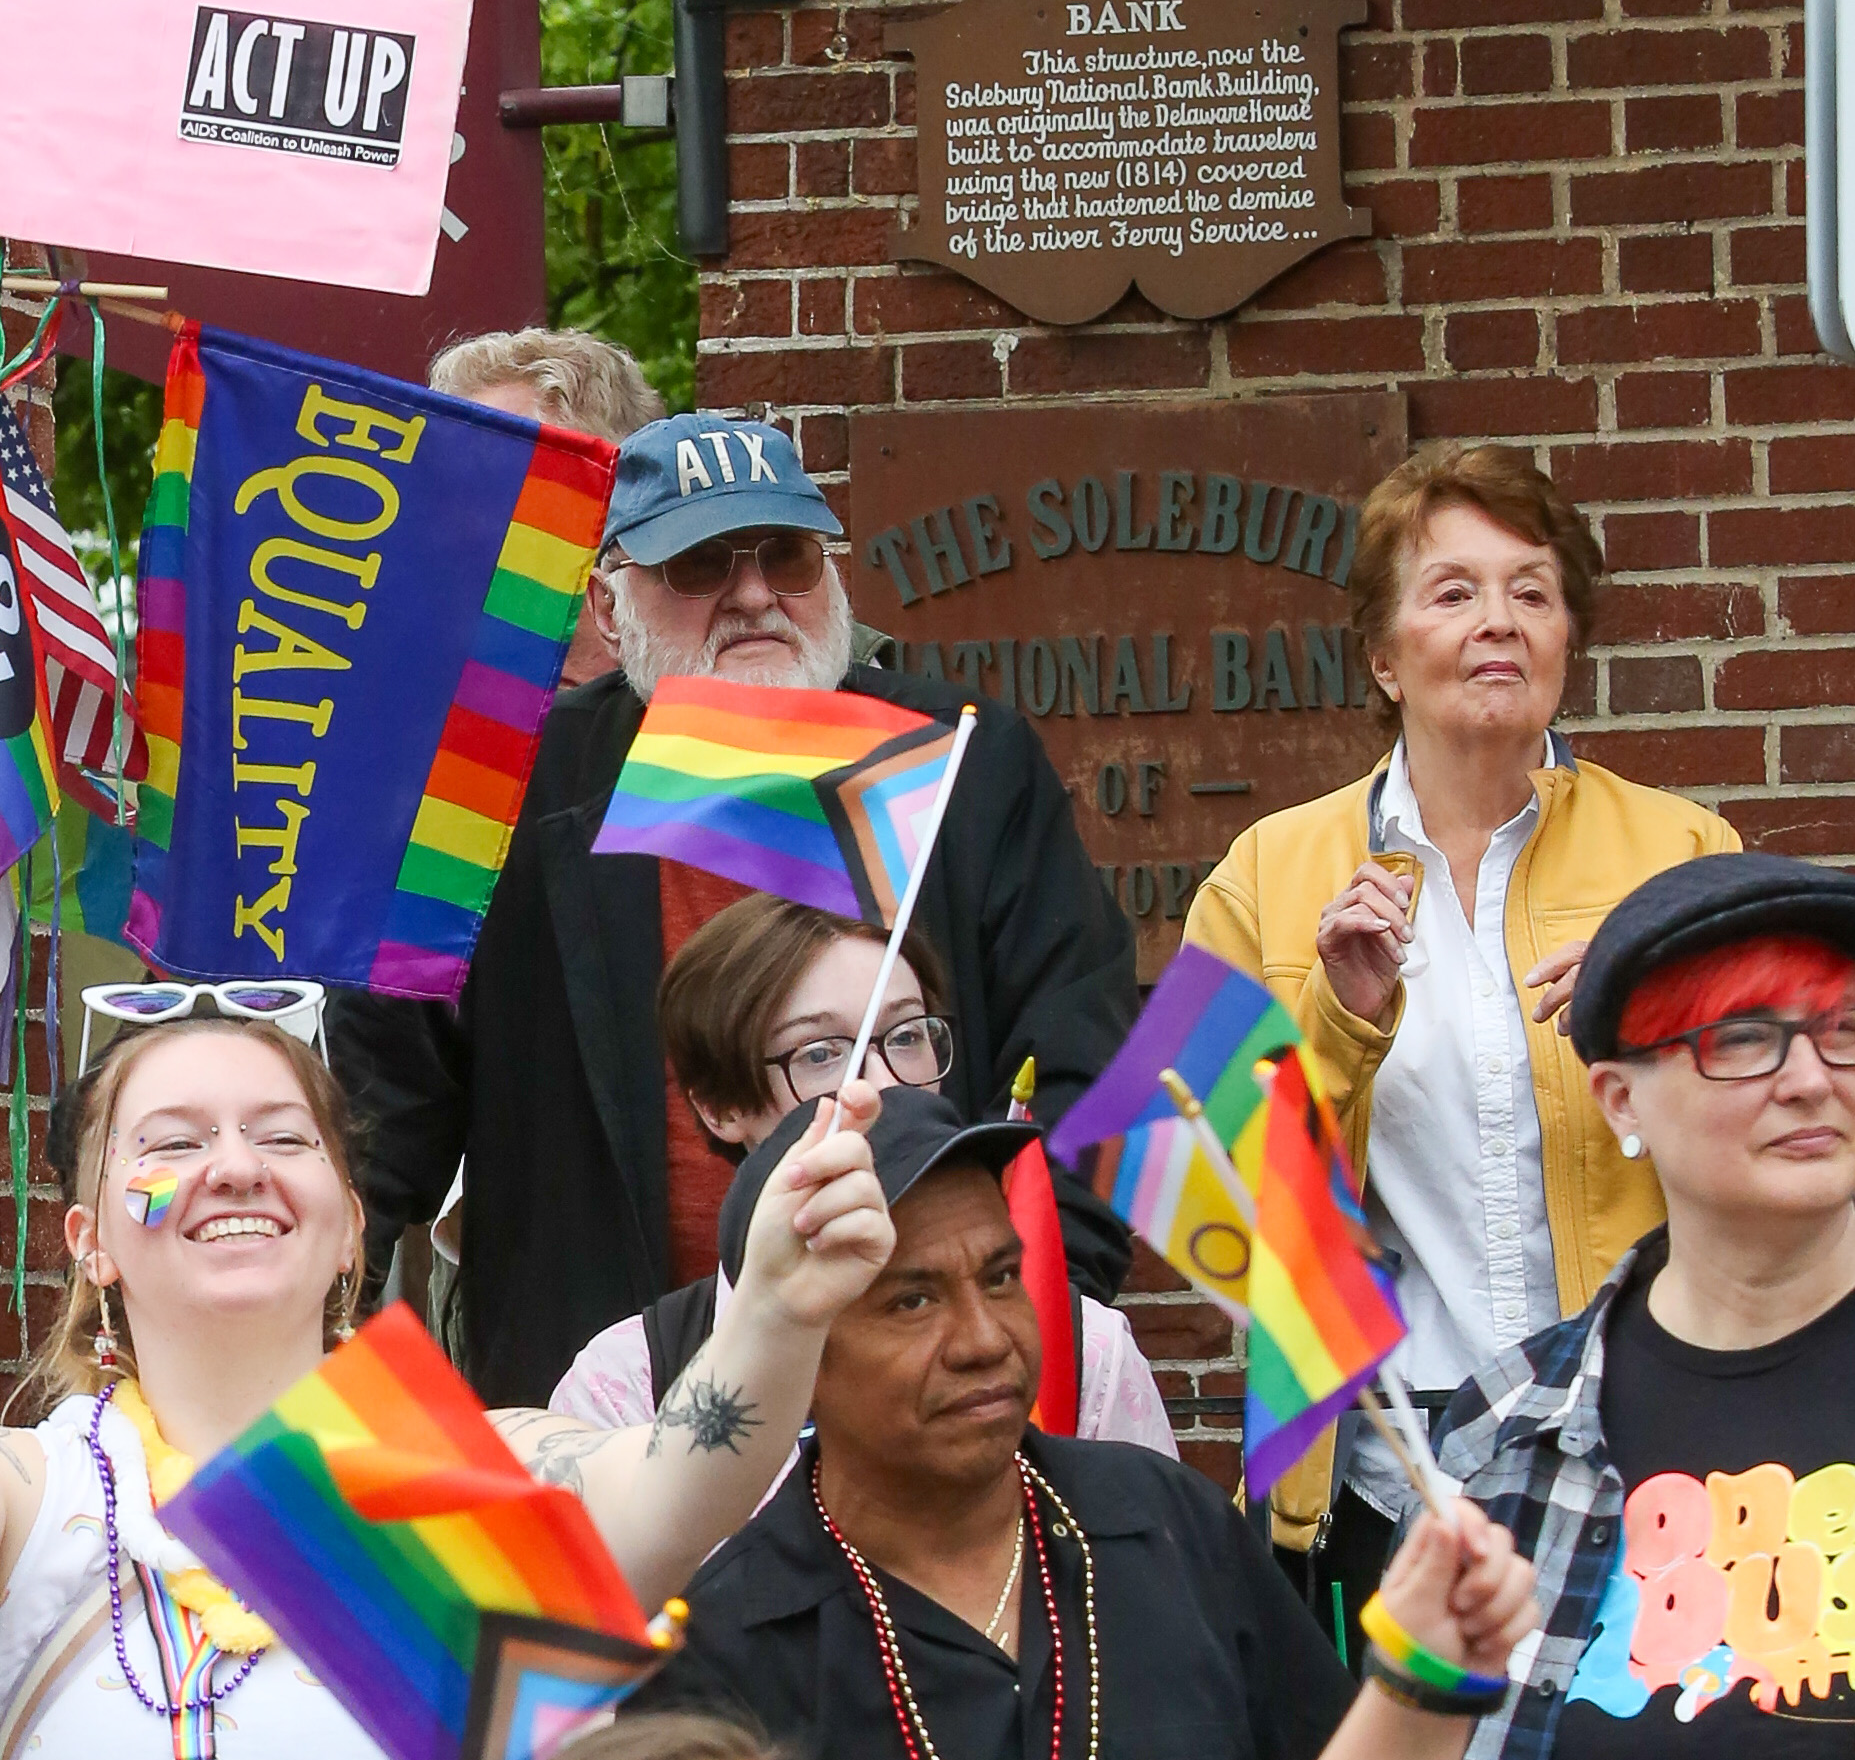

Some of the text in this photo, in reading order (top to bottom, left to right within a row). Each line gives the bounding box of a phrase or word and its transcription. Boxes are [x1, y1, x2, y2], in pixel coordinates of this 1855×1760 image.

[1066, 0, 1186, 36] BANK
[189, 13, 305, 118] ACT
[324, 29, 407, 132] UP
[1023, 49, 1081, 75] This
[1208, 47, 1254, 67] now
[1261, 39, 1305, 64] the
[946, 69, 1320, 113] Solebury National Bank Building,
[183, 122, 397, 164] AIDS Coalition to Unleash Power
[946, 98, 1313, 144] was originally the Delaware House
[948, 126, 1317, 165] built to accommodate travelers
[945, 155, 1307, 201] using the new (1814) covered
[945, 185, 1316, 230] bridge that hastened the demise
[948, 227, 978, 259] of
[983, 226, 1025, 253] the
[1028, 223, 1103, 251] river
[1108, 220, 1183, 257] Ferry
[675, 431, 778, 497] ATX
[870, 495, 1012, 607] THE
[231, 384, 425, 961] EQUALITY
[1211, 626, 1367, 712] BAN
[1097, 762, 1165, 816] OF
